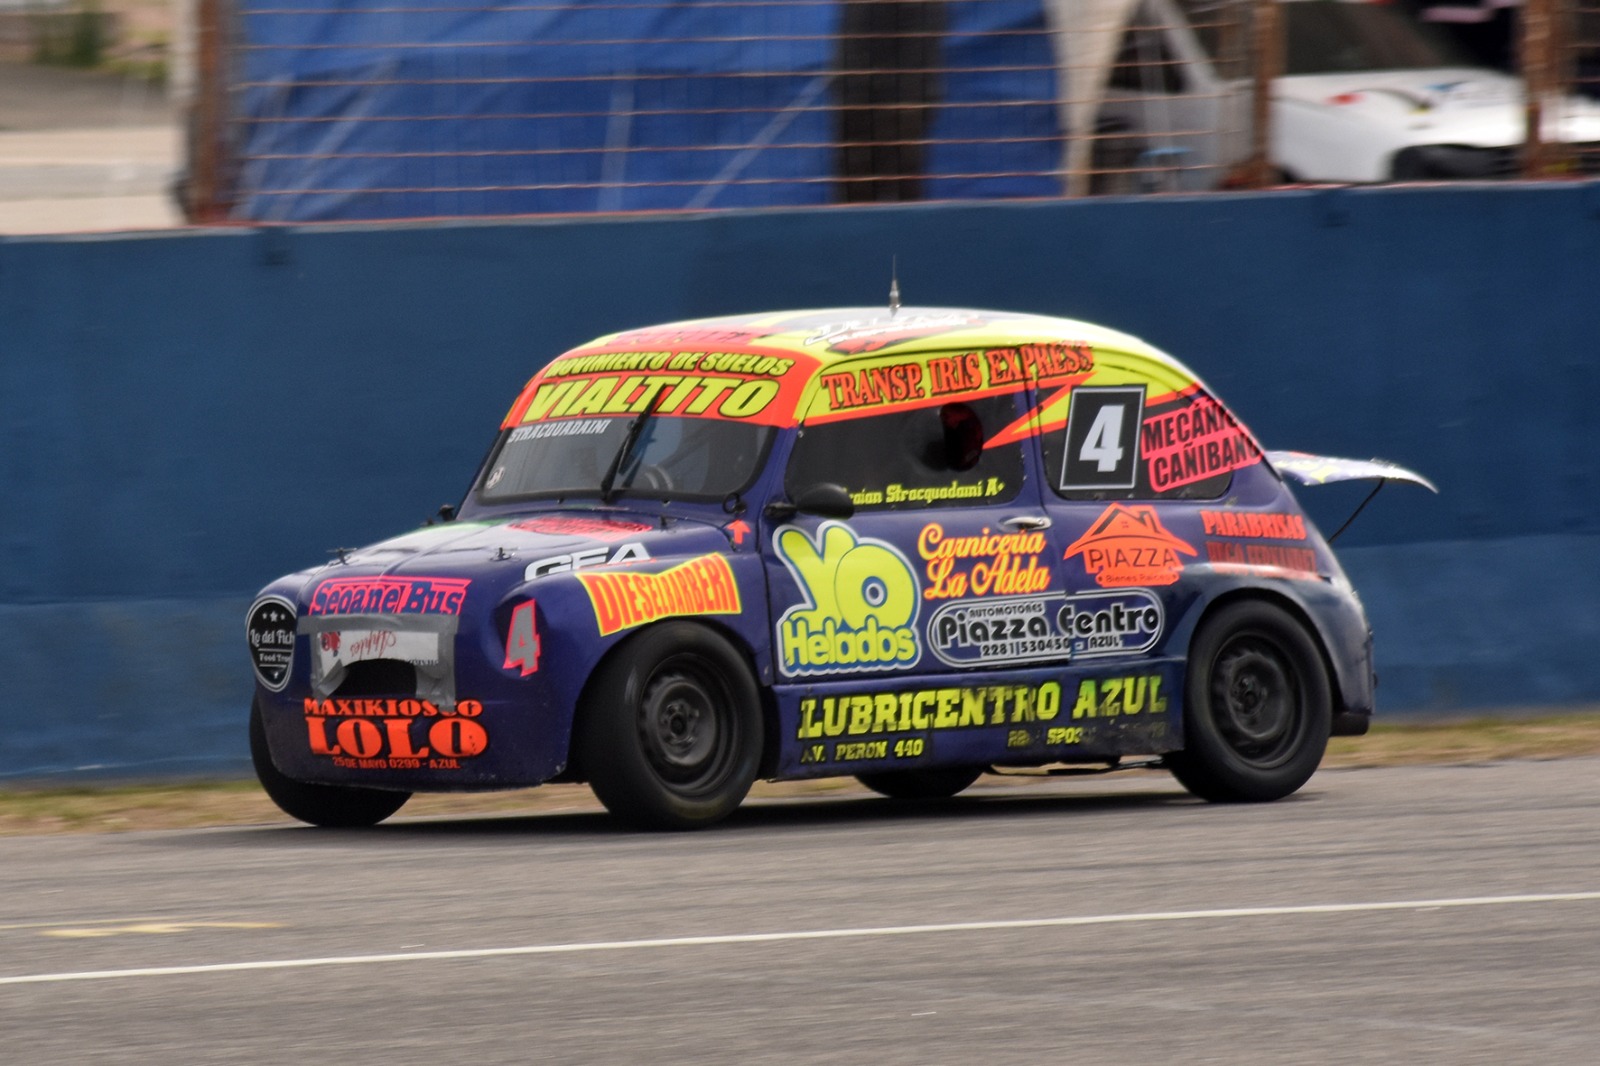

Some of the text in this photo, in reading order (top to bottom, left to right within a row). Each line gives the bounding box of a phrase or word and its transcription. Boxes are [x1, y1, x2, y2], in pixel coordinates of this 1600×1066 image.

[543, 352, 795, 378] MOVIMIENTO DE SUELOS
[820, 341, 1094, 411] TRANSP. IRIS EXPRESS
[521, 376, 780, 423] VIALTITO
[1078, 404, 1126, 473] 4
[924, 552, 1052, 600] La Adela
[1088, 547, 1178, 569] PIAZZA
[401, 580, 463, 616] Bus
[969, 602, 1044, 618] AUTOMOTORES
[503, 598, 541, 678] 4
[782, 616, 917, 666] Helados
[938, 602, 1160, 647] Piazza Centro
[1089, 635, 1121, 649] AZUL
[304, 697, 484, 718] MAXIKIOSO
[797, 675, 1168, 739] LUBRICENTRO AZUL
[305, 717, 488, 759] LOLO
[835, 740, 888, 761] PERON
[360, 758, 387, 769] MAYO
[429, 758, 461, 769] AZUL
